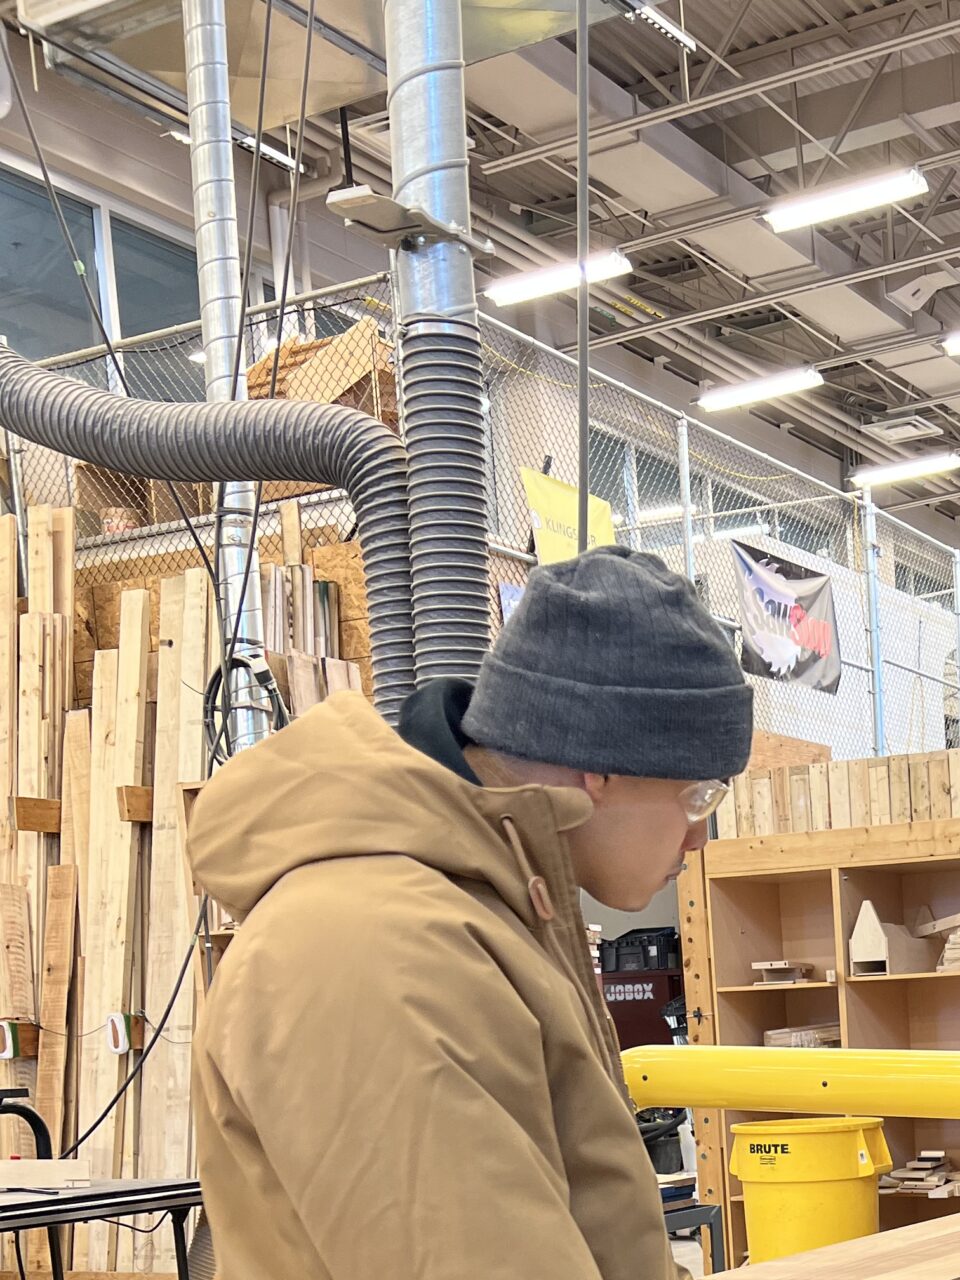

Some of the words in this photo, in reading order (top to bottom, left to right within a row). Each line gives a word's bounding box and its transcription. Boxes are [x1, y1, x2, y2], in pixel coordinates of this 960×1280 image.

[544, 517, 597, 547] KLINGSR
[605, 983, 654, 1001] JOBOX
[749, 1143, 790, 1155] BRUTE
